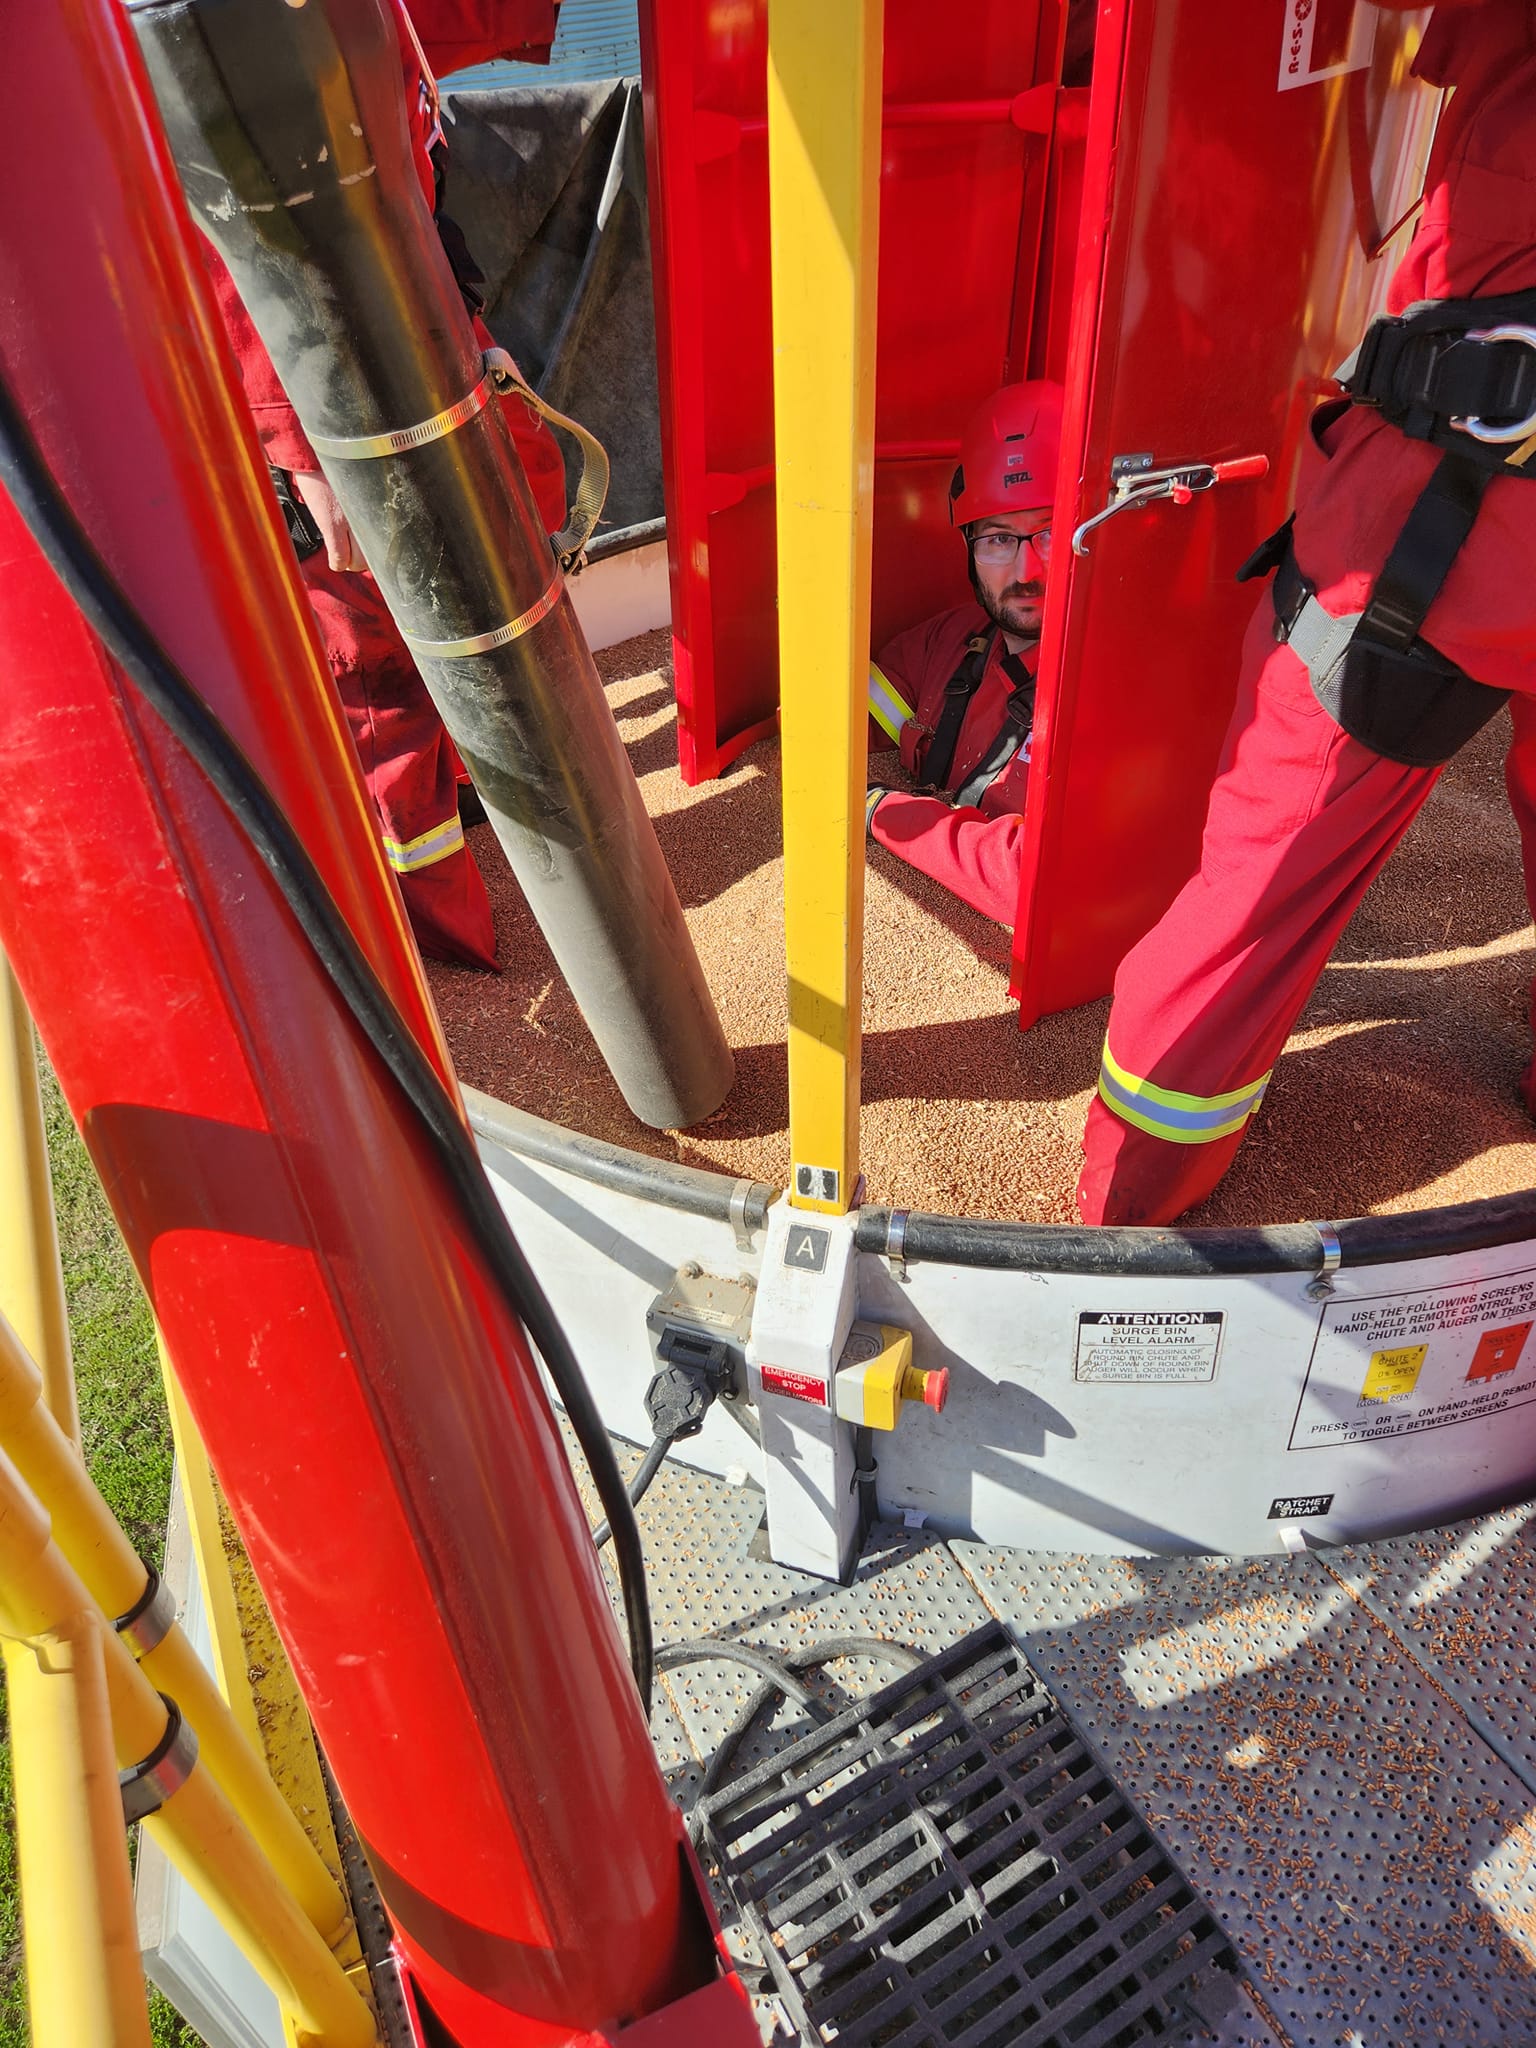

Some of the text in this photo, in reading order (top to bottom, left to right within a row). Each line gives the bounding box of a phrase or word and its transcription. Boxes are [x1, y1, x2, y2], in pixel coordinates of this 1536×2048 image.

[1003, 471, 1033, 489] PETZL
[796, 1235, 815, 1260] A
[1351, 1281, 1534, 1322] USE THE FOLLOWING SCREENS
[1098, 1313, 1204, 1324] ATTENTION
[1333, 1291, 1534, 1335] HAND-HELD REMOTE CONTROL TO
[1366, 1326, 1407, 1341] CHUTE
[1409, 1321, 1435, 1335] AND
[1437, 1314, 1478, 1330] AUGER
[1481, 1310, 1498, 1321] ON
[1502, 1303, 1527, 1318] THIS
[1112, 1327, 1187, 1335] SURGE BIN
[1102, 1336, 1195, 1344] LEVEL ALARM
[765, 1367, 823, 1387] EMERGENCY
[782, 1379, 806, 1391] STOP
[792, 1393, 824, 1405] MOTORS
[1418, 1408, 1434, 1417] ON
[1437, 1391, 1499, 1414] HAND-HELD
[1343, 1399, 1508, 1440] TO TOGGLE BETWEEN SCREENS
[1375, 1415, 1391, 1425] OR
[1311, 1421, 1349, 1434] PRESS
[1275, 1497, 1330, 1509] RATCHET
[1280, 1506, 1319, 1517] STRAP
